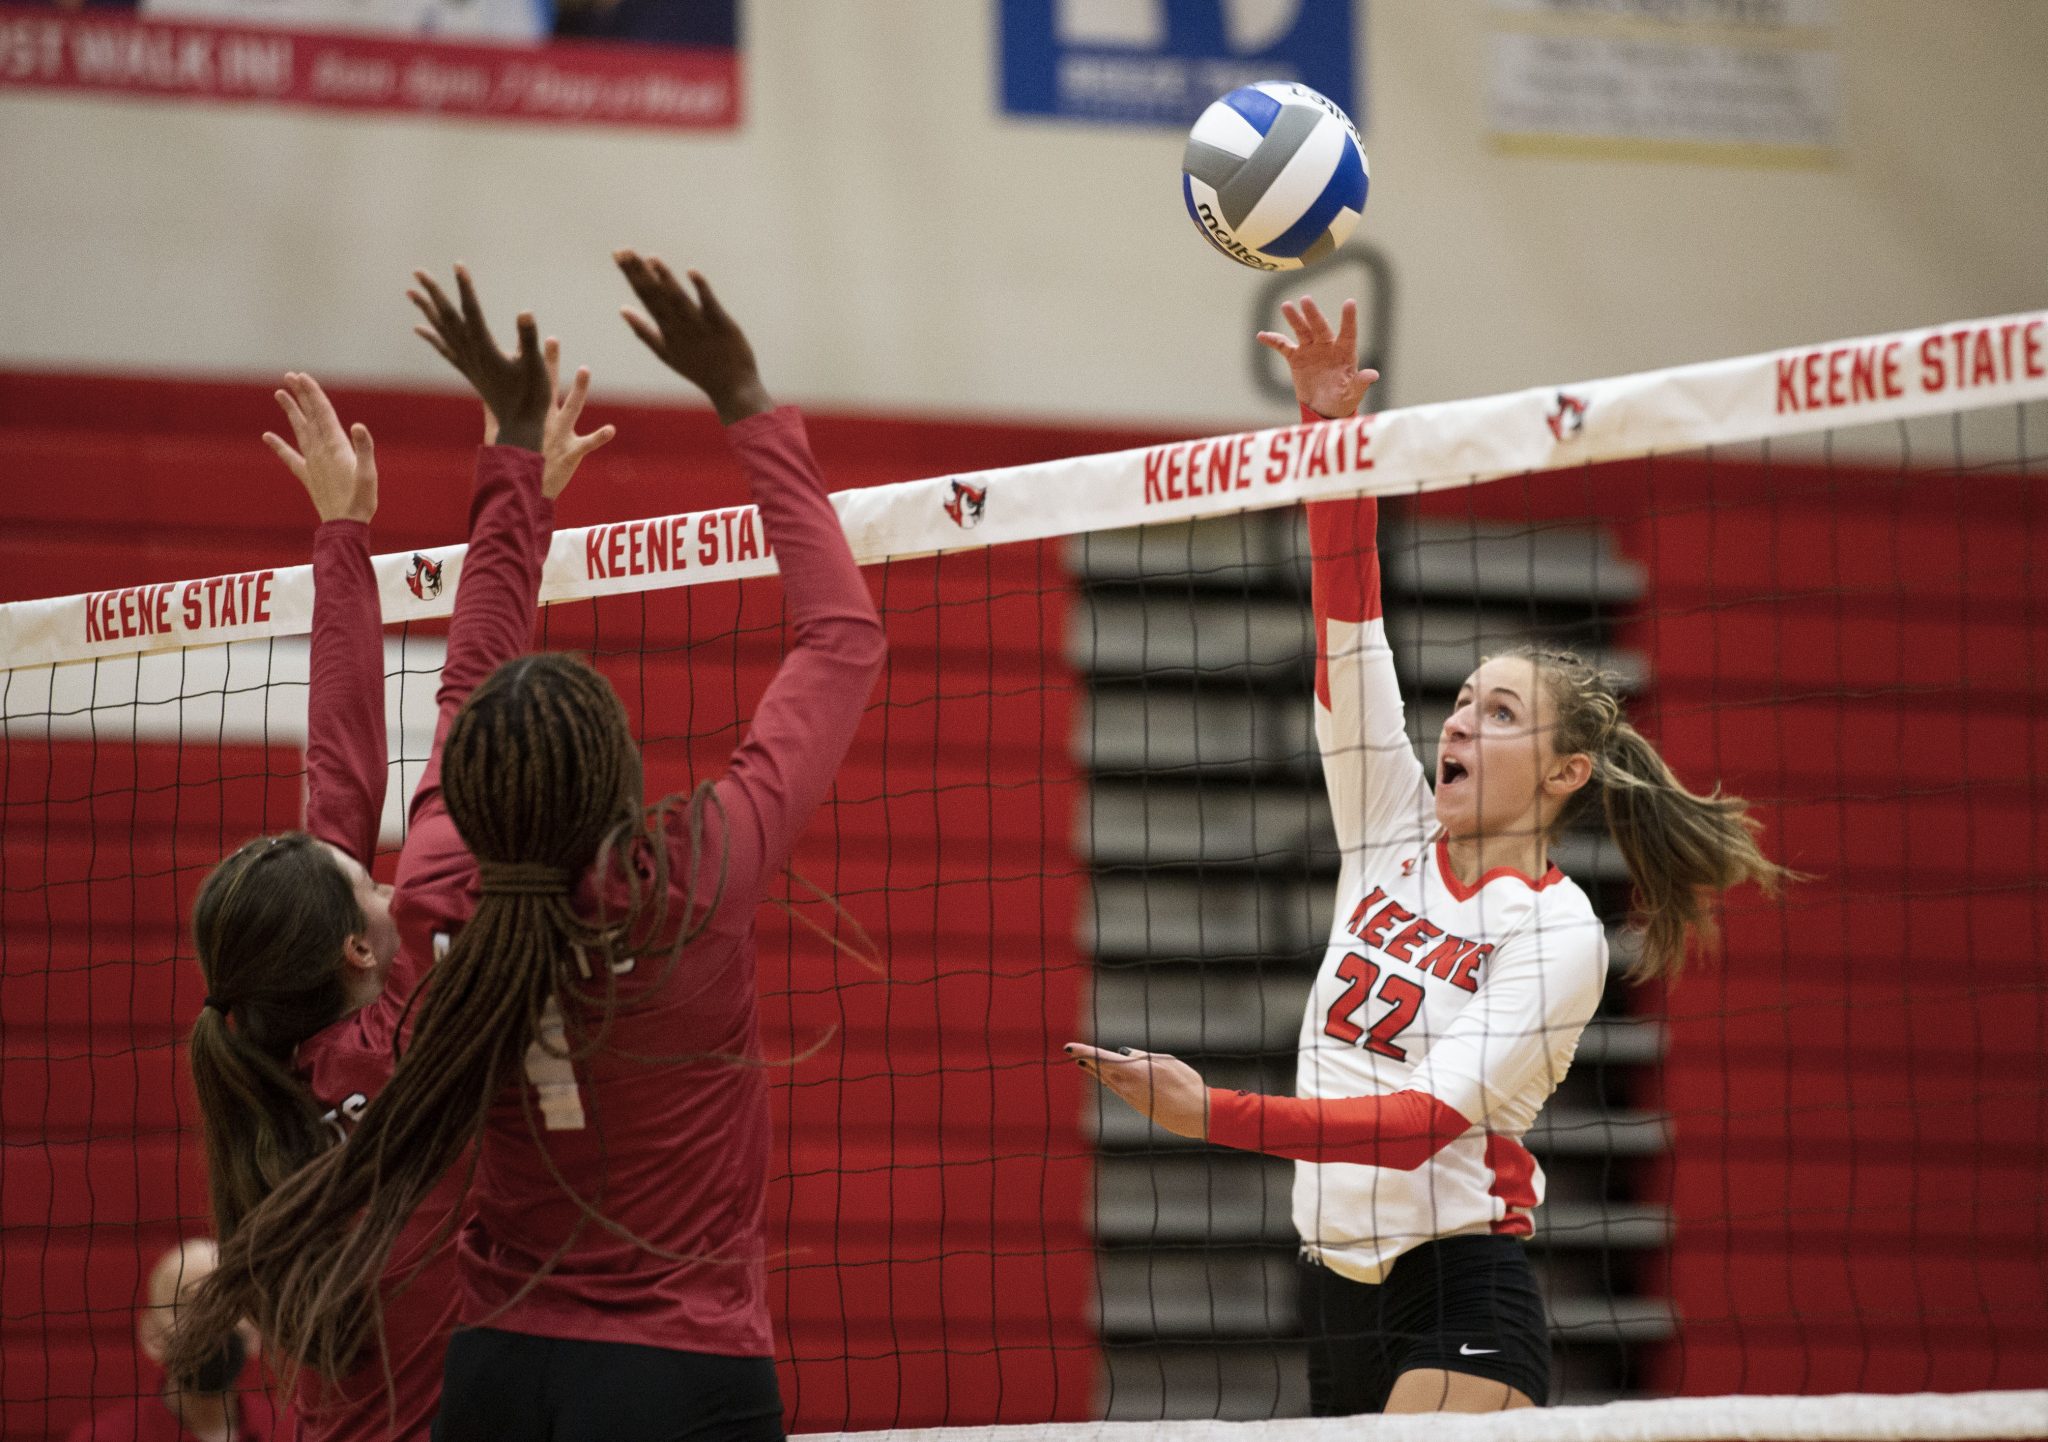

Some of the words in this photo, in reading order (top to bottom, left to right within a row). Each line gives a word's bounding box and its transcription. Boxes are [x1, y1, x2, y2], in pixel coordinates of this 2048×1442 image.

[1198, 203, 1279, 271] molten
[1776, 342, 1904, 415] KEENE
[1920, 321, 2045, 393] STATE
[1145, 433, 1257, 504] KEENE
[1264, 415, 1377, 484] STATE
[586, 517, 688, 580] KEENE
[698, 509, 774, 566] STA
[86, 583, 176, 643] KEENE
[182, 571, 274, 630] STATE
[1324, 951, 1426, 1062] 22
